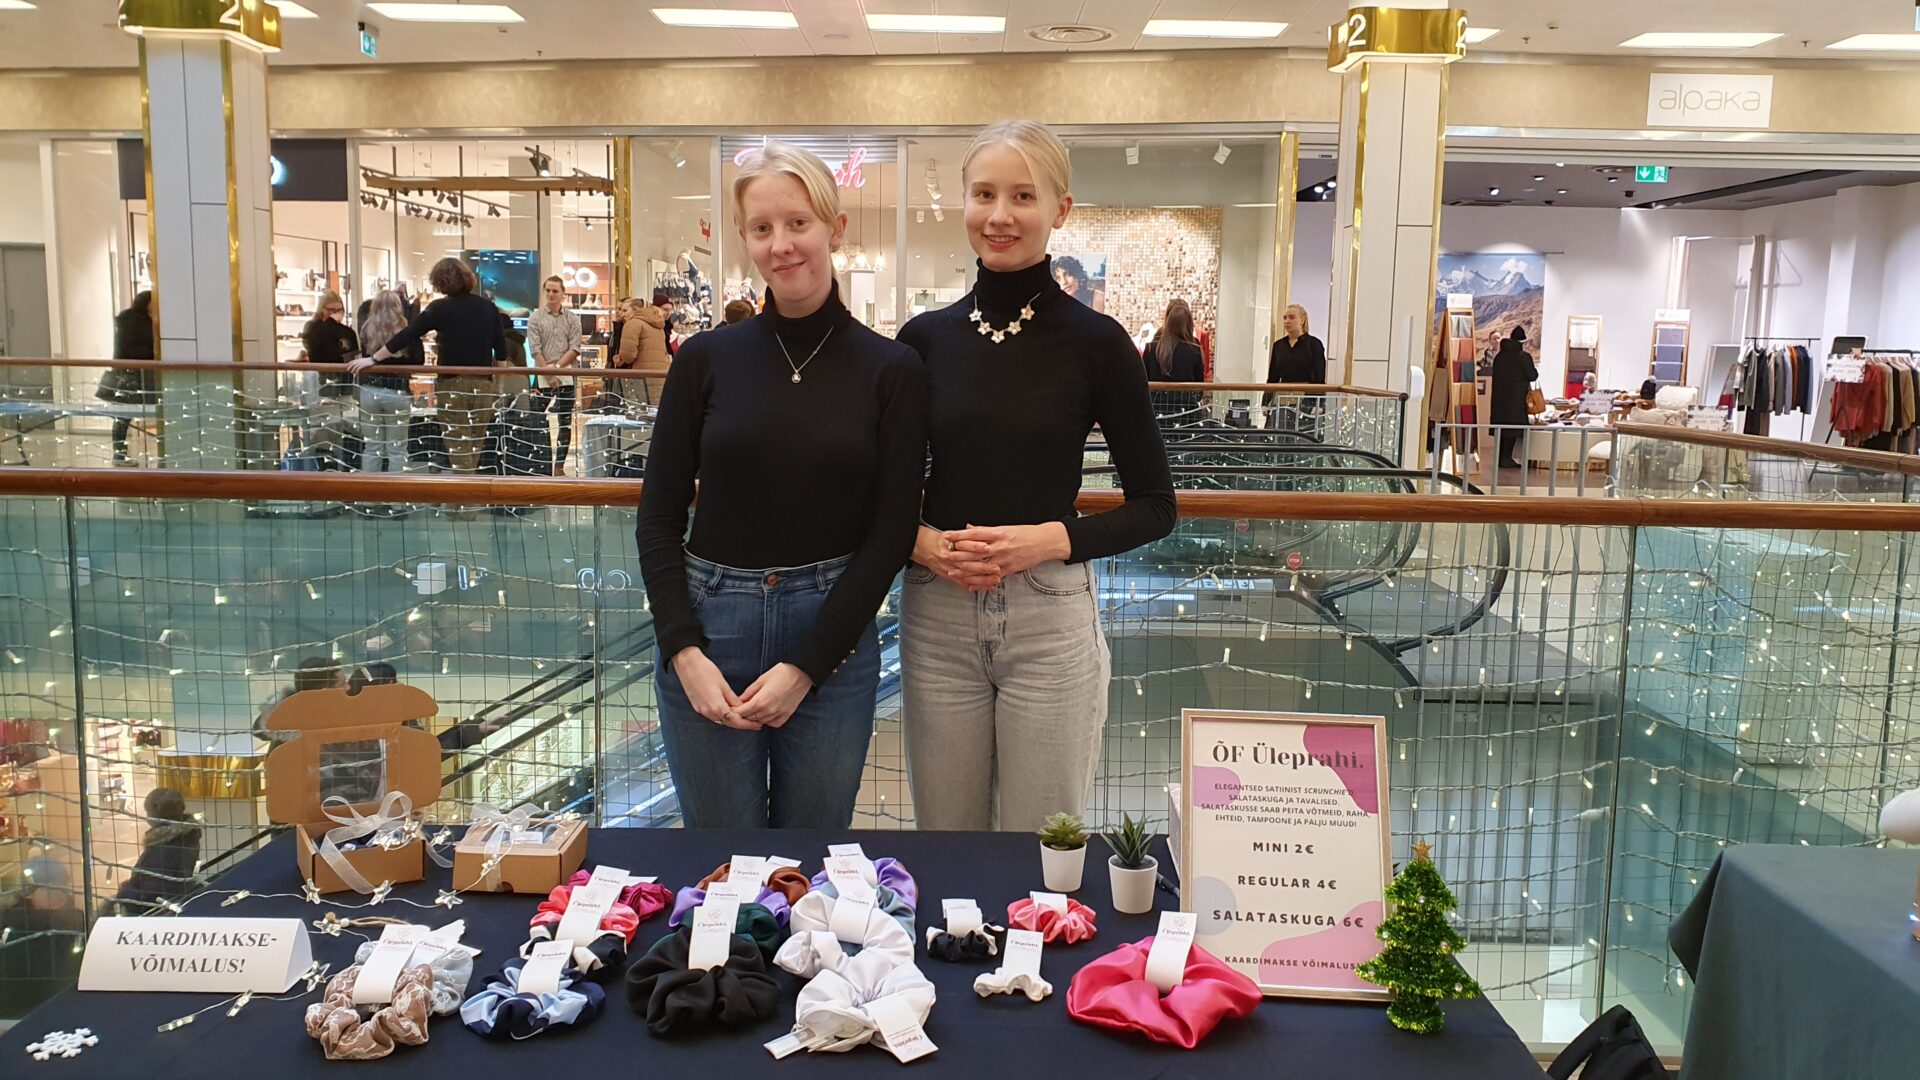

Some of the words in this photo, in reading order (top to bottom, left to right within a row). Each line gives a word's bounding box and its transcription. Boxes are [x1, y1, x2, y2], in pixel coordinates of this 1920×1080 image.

[1348, 14, 1367, 46] 2
[1658, 82, 1761, 117] alpaka
[1212, 740, 1245, 763] ÕF
[1253, 742, 1364, 770] Üleprahi.
[1214, 783, 1263, 792] ELEGANTSED
[1265, 785, 1302, 794] SATIINIST
[1228, 794, 1284, 803] SALATASKUGA
[1285, 796, 1294, 804] JA
[1296, 797, 1340, 806] TAVALISED.
[1201, 803, 1258, 812] SALATASKUSSE
[1260, 806, 1281, 814] SAAB
[1282, 807, 1304, 815] PEITA
[1306, 807, 1345, 817] VÕTMEID,
[1346, 810, 1371, 818] RAHA,
[1215, 814, 1244, 823] EHTEID,
[1246, 816, 1292, 825] TAMPOONE
[1293, 818, 1302, 826] JA
[1304, 818, 1328, 827] PALJU
[1329, 820, 1357, 828] MUUD!
[1253, 842, 1288, 853] MINI
[1295, 843, 1314, 854] 2€
[1237, 875, 1310, 888] REGULAR
[1317, 879, 1337, 890] 4€
[1213, 910, 1336, 927] SALATASKUGA
[1343, 917, 1364, 928] 6€
[116, 931, 277, 947] KAARDIMAKSE-
[129, 953, 246, 973] VÕIMALUS!
[1224, 956, 1298, 967] KAARDIMAKSE
